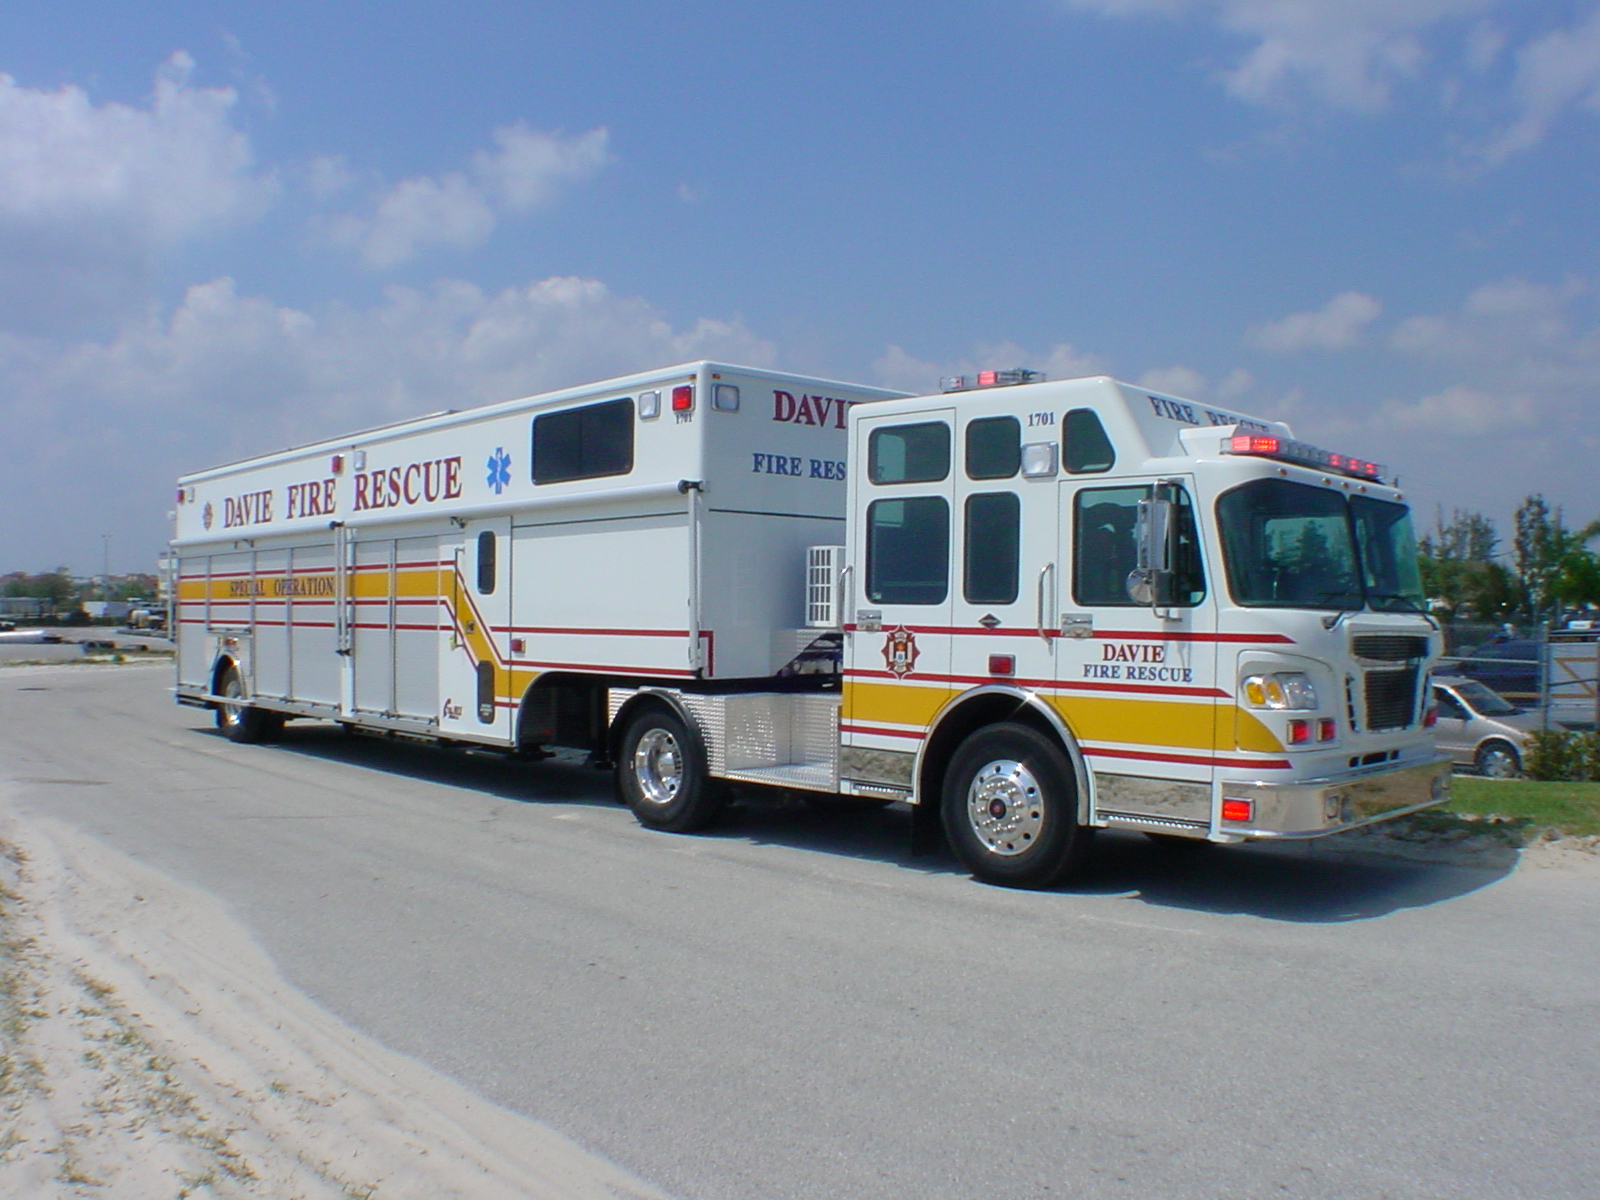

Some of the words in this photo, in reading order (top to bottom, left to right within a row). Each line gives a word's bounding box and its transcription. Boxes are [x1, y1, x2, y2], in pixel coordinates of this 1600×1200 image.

[773, 390, 863, 429] DAVI
[1028, 411, 1054, 427] 1701
[1147, 395, 1199, 425] FIRE
[752, 453, 802, 477] FIRE
[223, 490, 273, 528] DAVIE
[286, 478, 336, 519] FIRE
[353, 456, 462, 512] RESCUE
[230, 579, 265, 597] SPECIAL
[1102, 643, 1165, 663] DAVIE
[1083, 664, 1120, 679] FIRE
[1126, 666, 1193, 683] RESCUE
